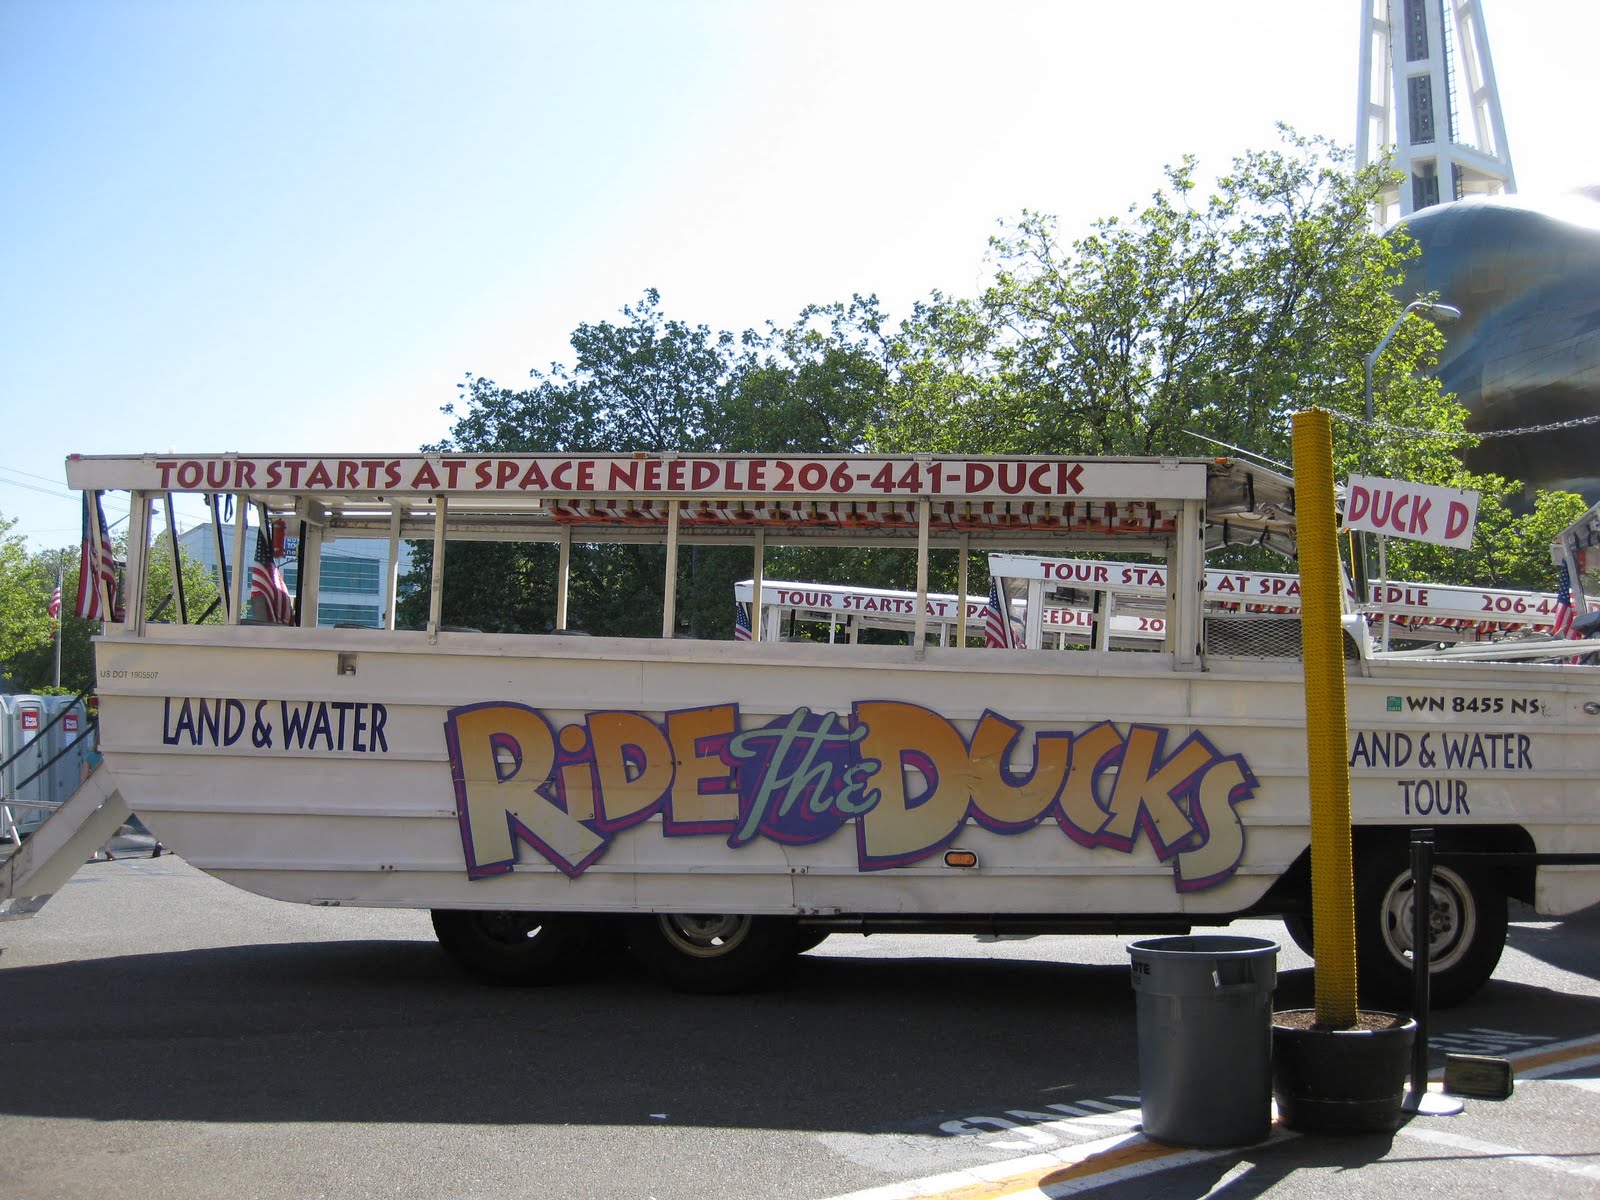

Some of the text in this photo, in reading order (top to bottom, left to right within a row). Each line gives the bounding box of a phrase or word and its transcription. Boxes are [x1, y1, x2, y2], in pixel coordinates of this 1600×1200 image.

[156, 460, 1085, 495] TOUR STARTS AT SPACE NEEDLE 206-441-DUCK
[1348, 485, 1469, 540] DUCK D
[1040, 562, 1109, 583] TOUR
[1121, 568, 1165, 588] STA
[1217, 575, 1250, 592] AT
[1260, 578, 1300, 597] SPA
[777, 590, 833, 607] TOUR
[843, 595, 913, 614] STARTS
[926, 600, 948, 616] AT
[100, 670, 111, 678] US
[112, 670, 128, 679] DOT
[1406, 695, 1539, 714] WN 8455 NS
[163, 696, 388, 752] LAND & WATER
[1348, 731, 1533, 769] AND & WATER
[1398, 779, 1470, 815] TOUR
